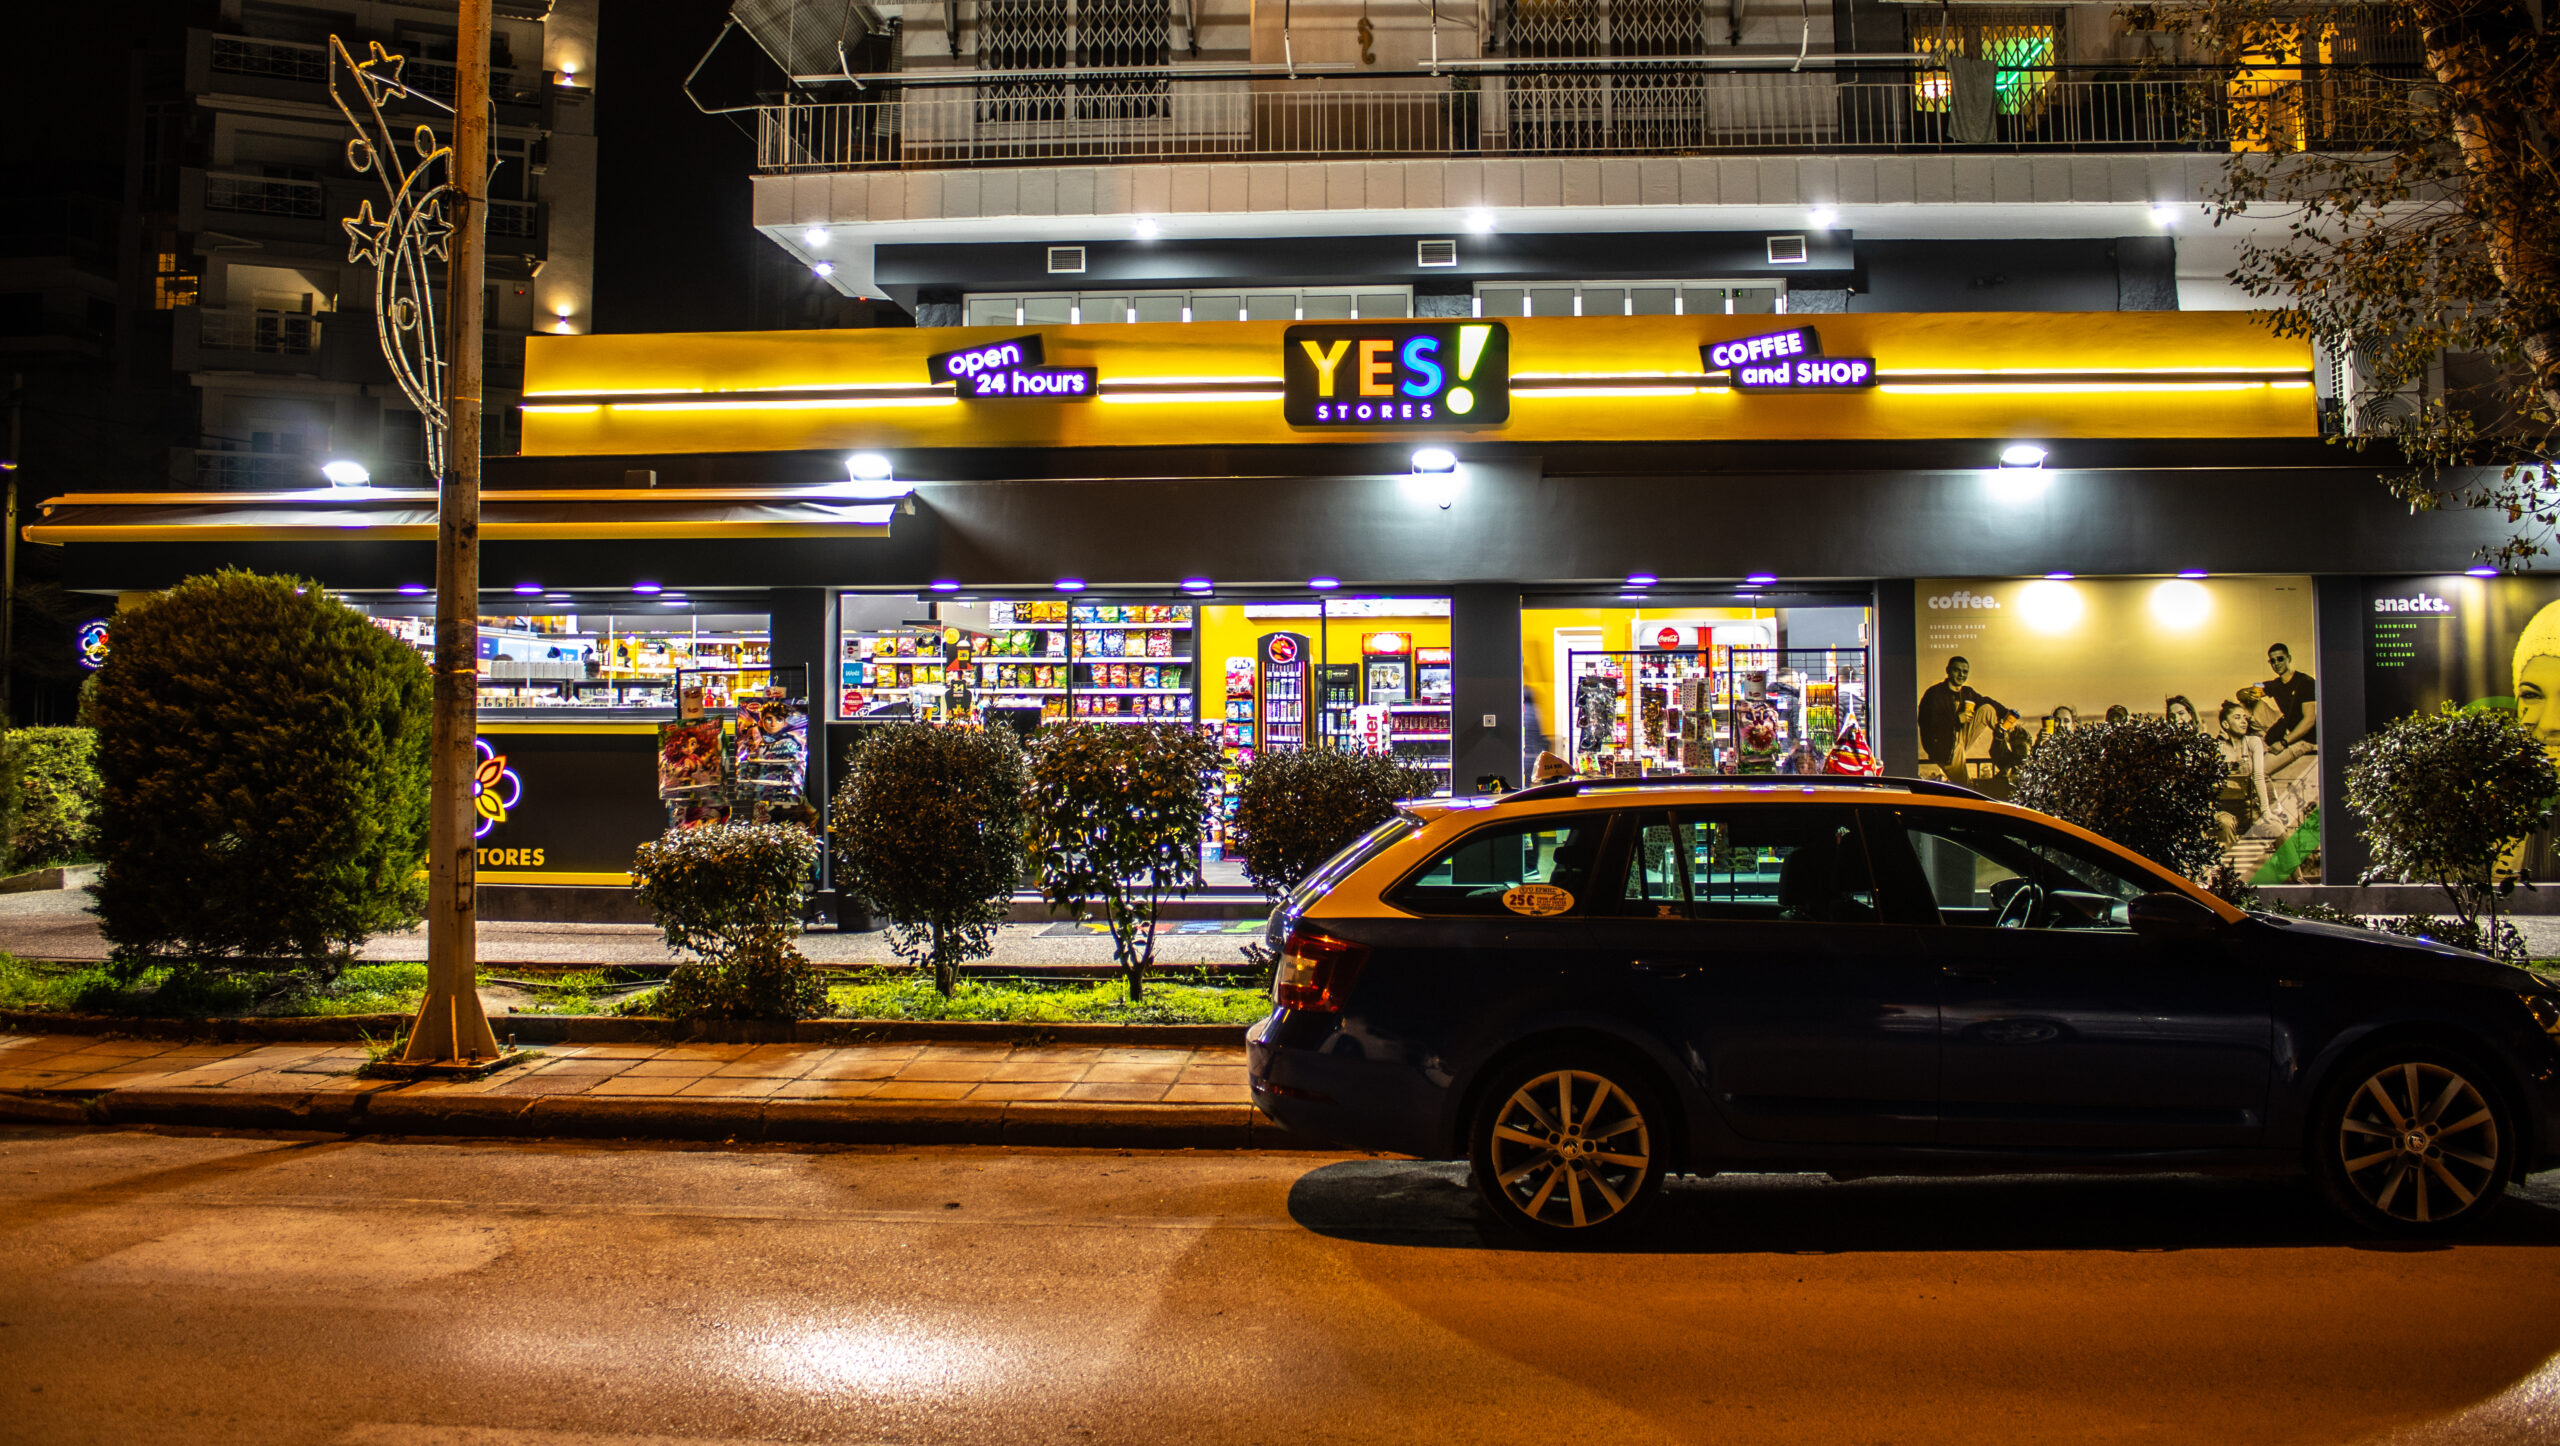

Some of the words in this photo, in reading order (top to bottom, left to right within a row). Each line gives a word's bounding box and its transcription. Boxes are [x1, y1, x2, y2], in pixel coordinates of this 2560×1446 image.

[1712, 332, 1803, 367] COFFEE
[948, 345, 1020, 377] open
[1300, 325, 1492, 415] YES!
[975, 373, 1006, 394] 24
[1012, 371, 1085, 394] hours
[1741, 362, 1790, 384] and
[1796, 362, 1868, 384] SHOP
[1317, 403, 1433, 419] STORES
[1928, 590, 2001, 610] coffee.
[2374, 592, 2451, 612] snacks.
[476, 848, 545, 867] TORES
